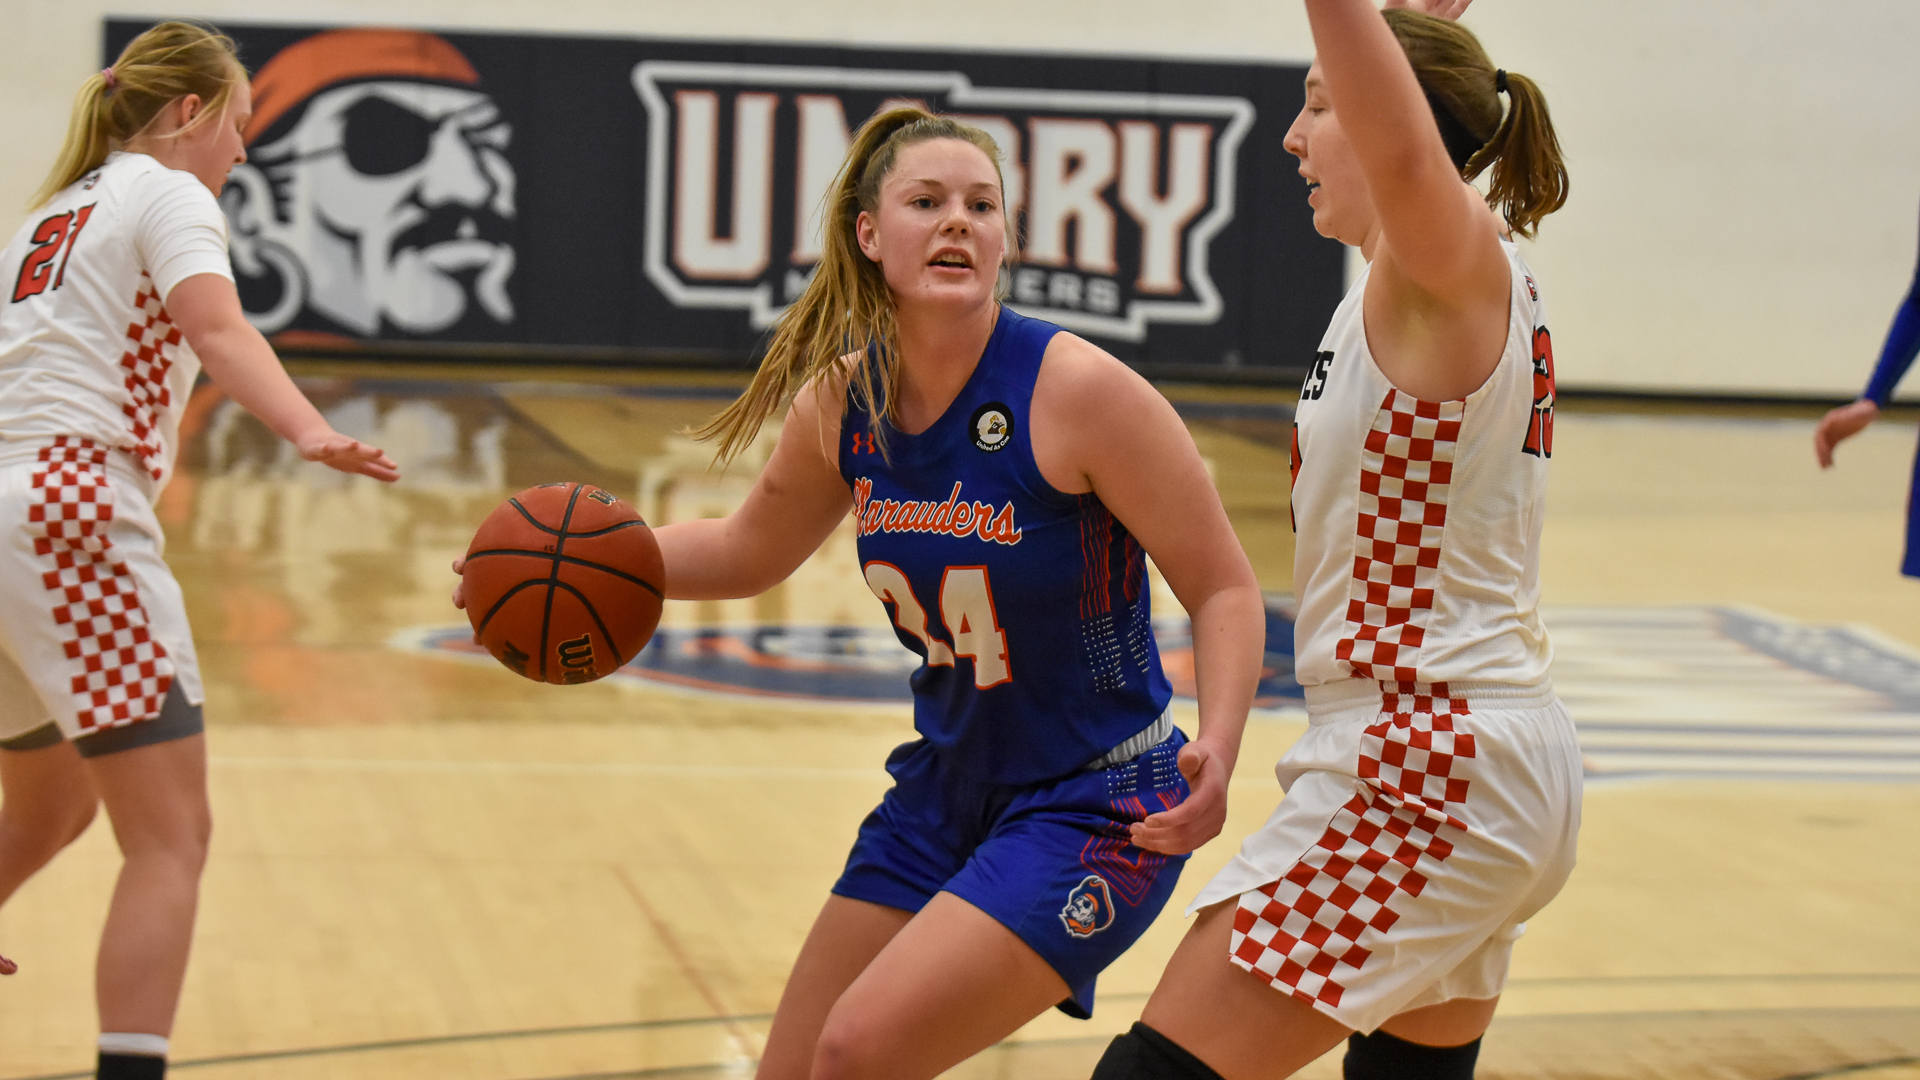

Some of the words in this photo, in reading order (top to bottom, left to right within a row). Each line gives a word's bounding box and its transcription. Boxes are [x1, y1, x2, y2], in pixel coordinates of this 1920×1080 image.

[11, 201, 97, 304] 21
[853, 477, 1022, 545] Marauders
[864, 560, 1013, 691] 24
